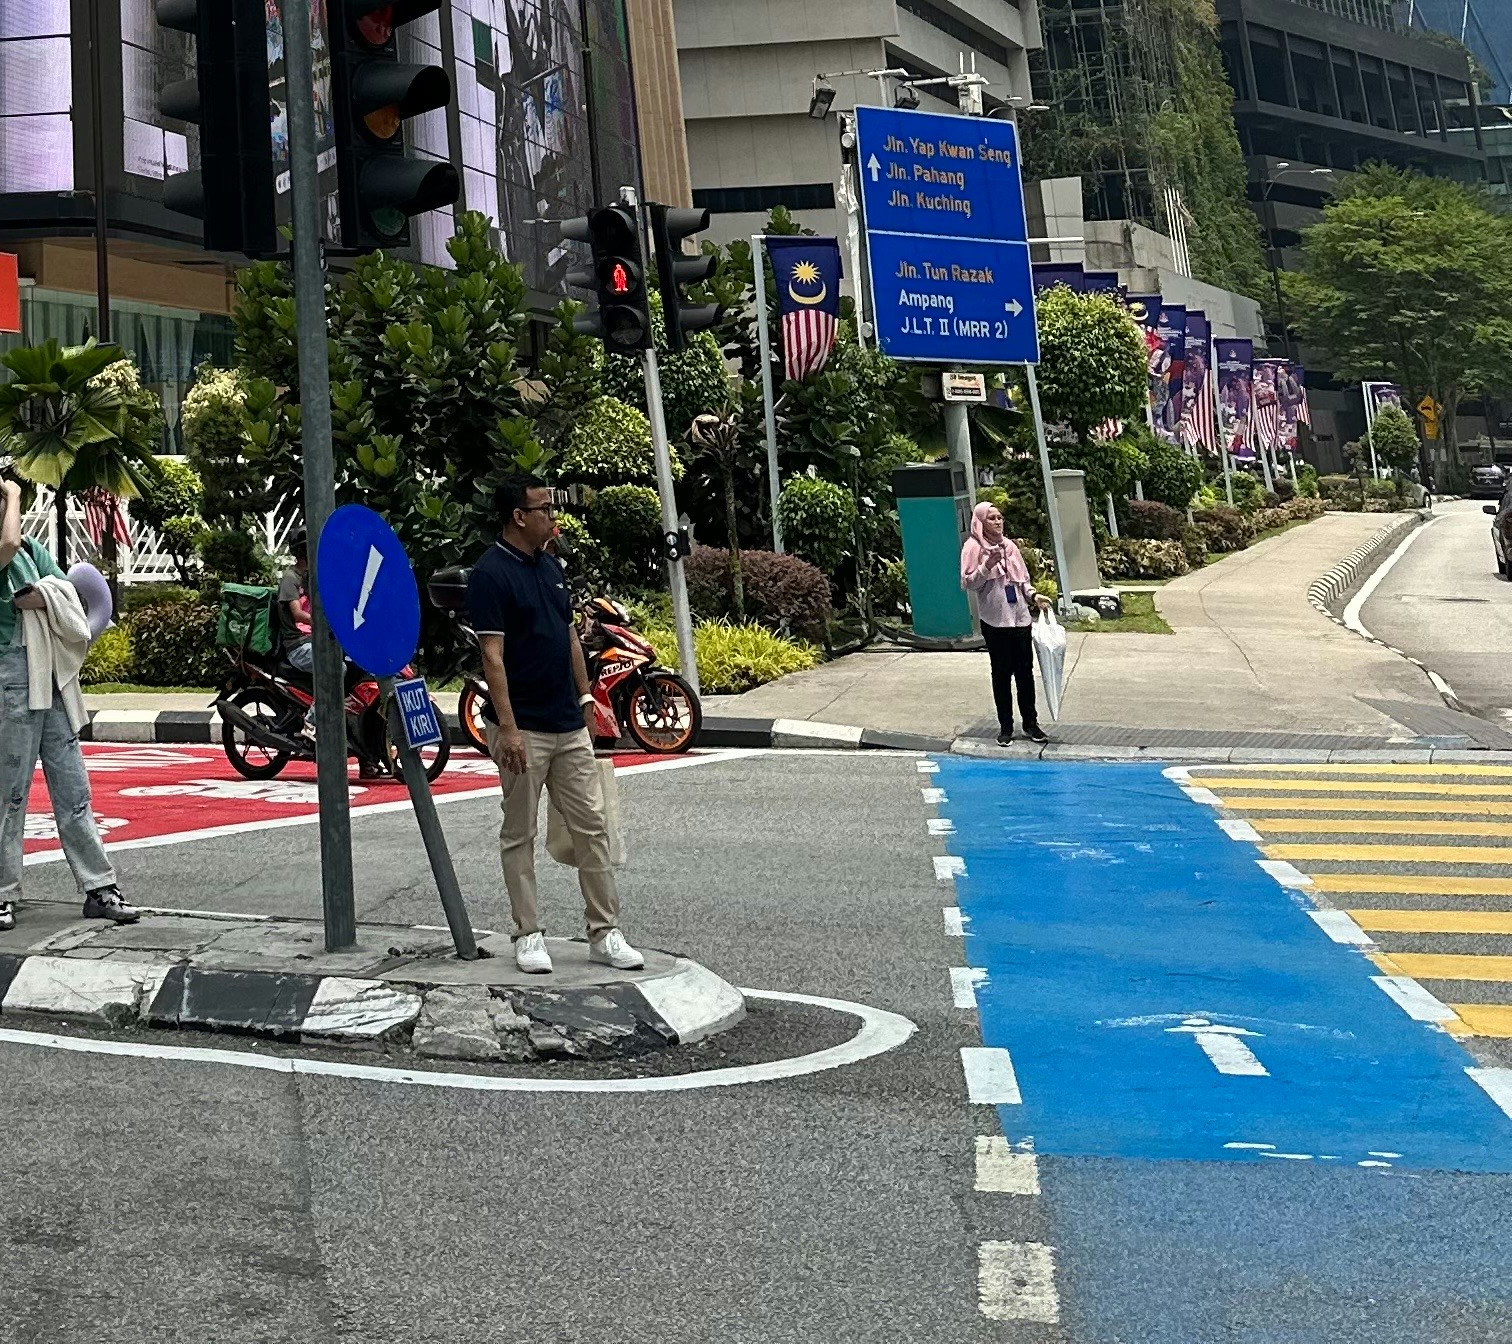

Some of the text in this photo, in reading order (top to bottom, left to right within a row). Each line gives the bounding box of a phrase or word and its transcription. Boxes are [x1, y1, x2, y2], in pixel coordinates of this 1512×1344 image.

[883, 134, 1011, 168] Jln. Yap Kwan Seng
[886, 162, 965, 191] Jln. Pahang
[888, 190, 971, 218] Jln. Kuching
[895, 260, 994, 284] Jln. Tun Razak
[898, 288, 954, 314] Ampang
[901, 316, 934, 335] J.L.T.
[953, 317, 990, 338] (MRR
[995, 319, 1008, 339] 2)
[401, 687, 426, 712] IKUT
[409, 712, 435, 738] KIRI
